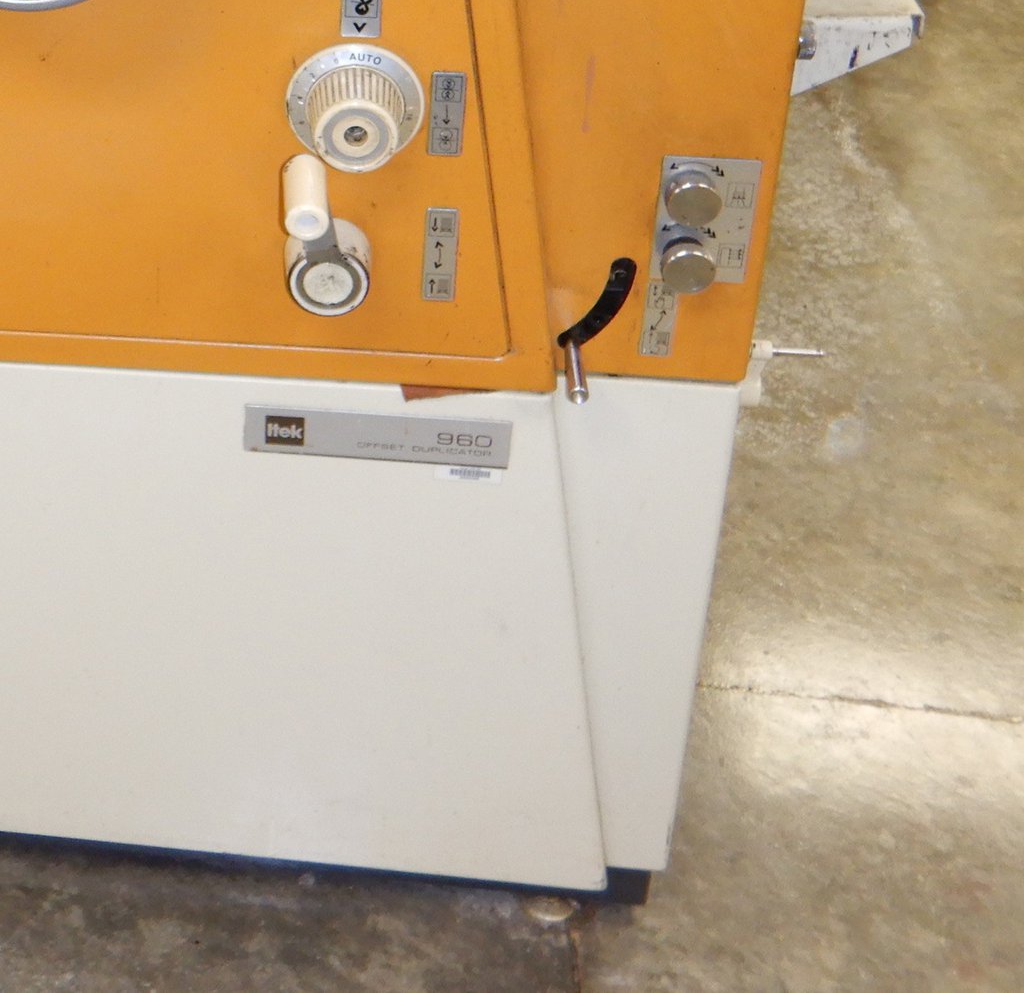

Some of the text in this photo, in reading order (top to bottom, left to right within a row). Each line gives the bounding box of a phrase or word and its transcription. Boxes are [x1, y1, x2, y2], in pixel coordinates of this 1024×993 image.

[349, 52, 382, 65] AUTO
[357, 440, 492, 457] OFFSET DUPLICATOR
[436, 432, 492, 449] 960
